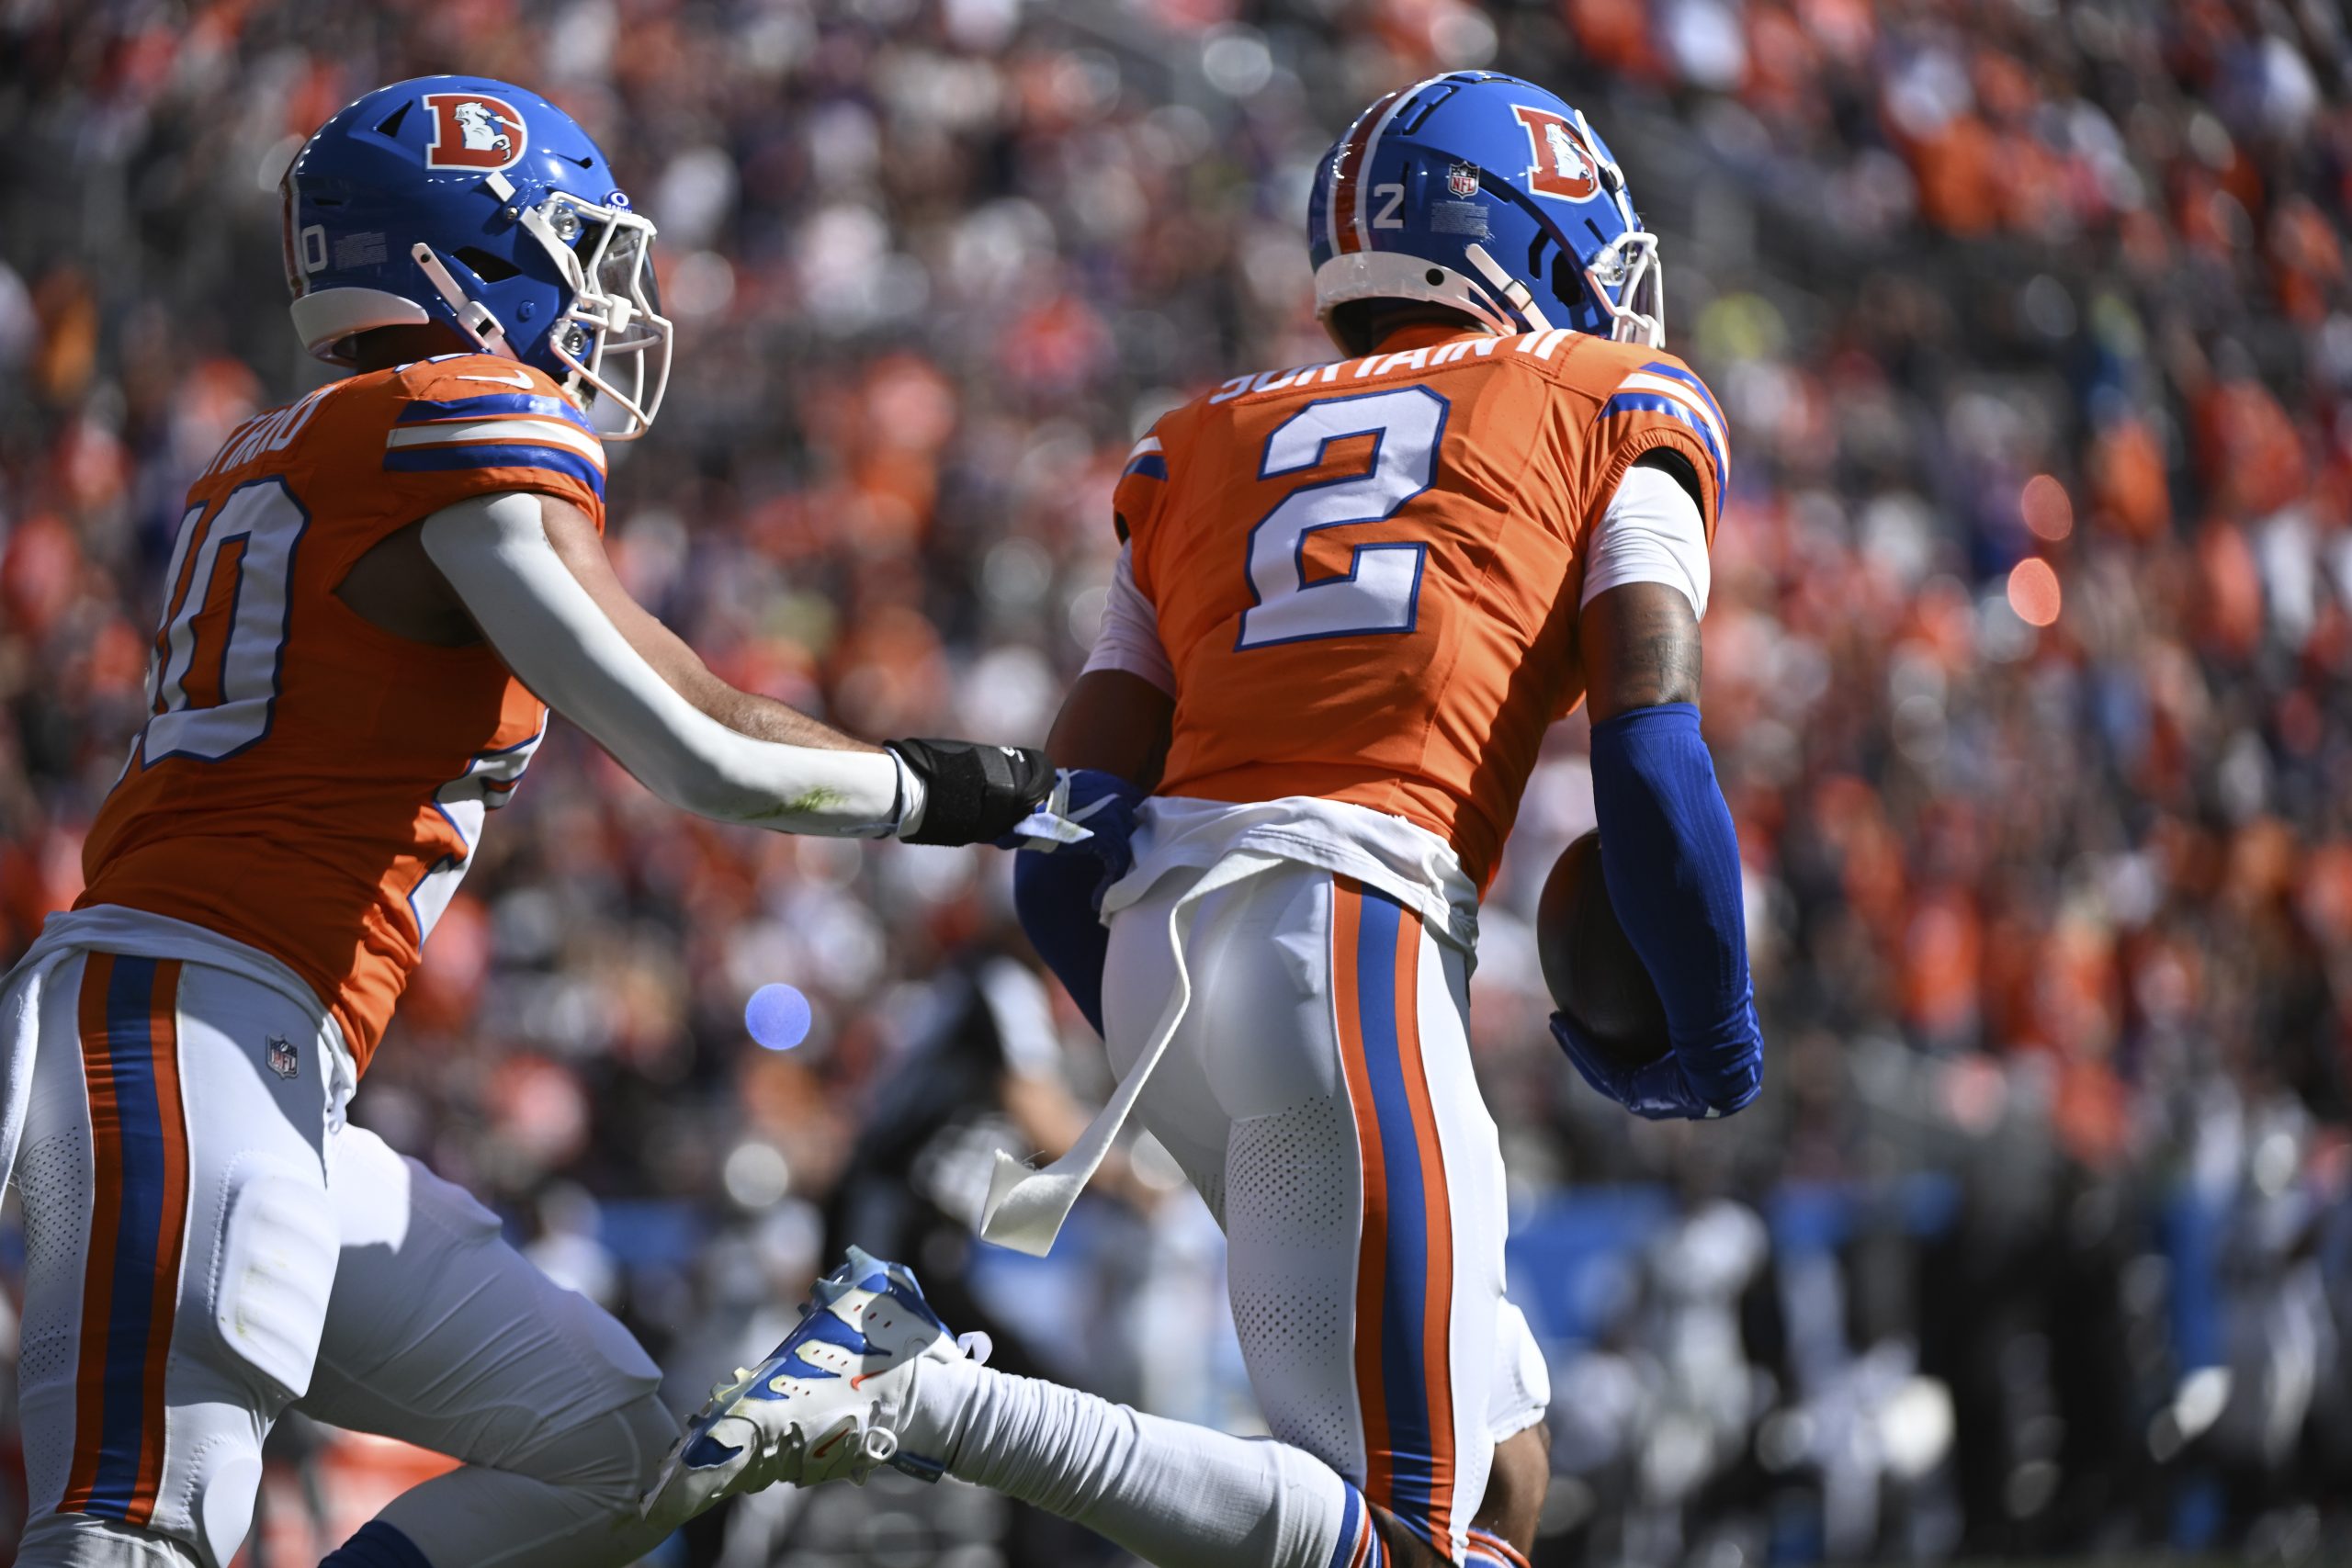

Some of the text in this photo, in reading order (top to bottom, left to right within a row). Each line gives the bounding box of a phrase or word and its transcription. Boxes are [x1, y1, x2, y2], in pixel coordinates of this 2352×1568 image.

[1373, 184, 1404, 229] 2
[129, 474, 311, 773] 0
[1235, 384, 1450, 650] 2
